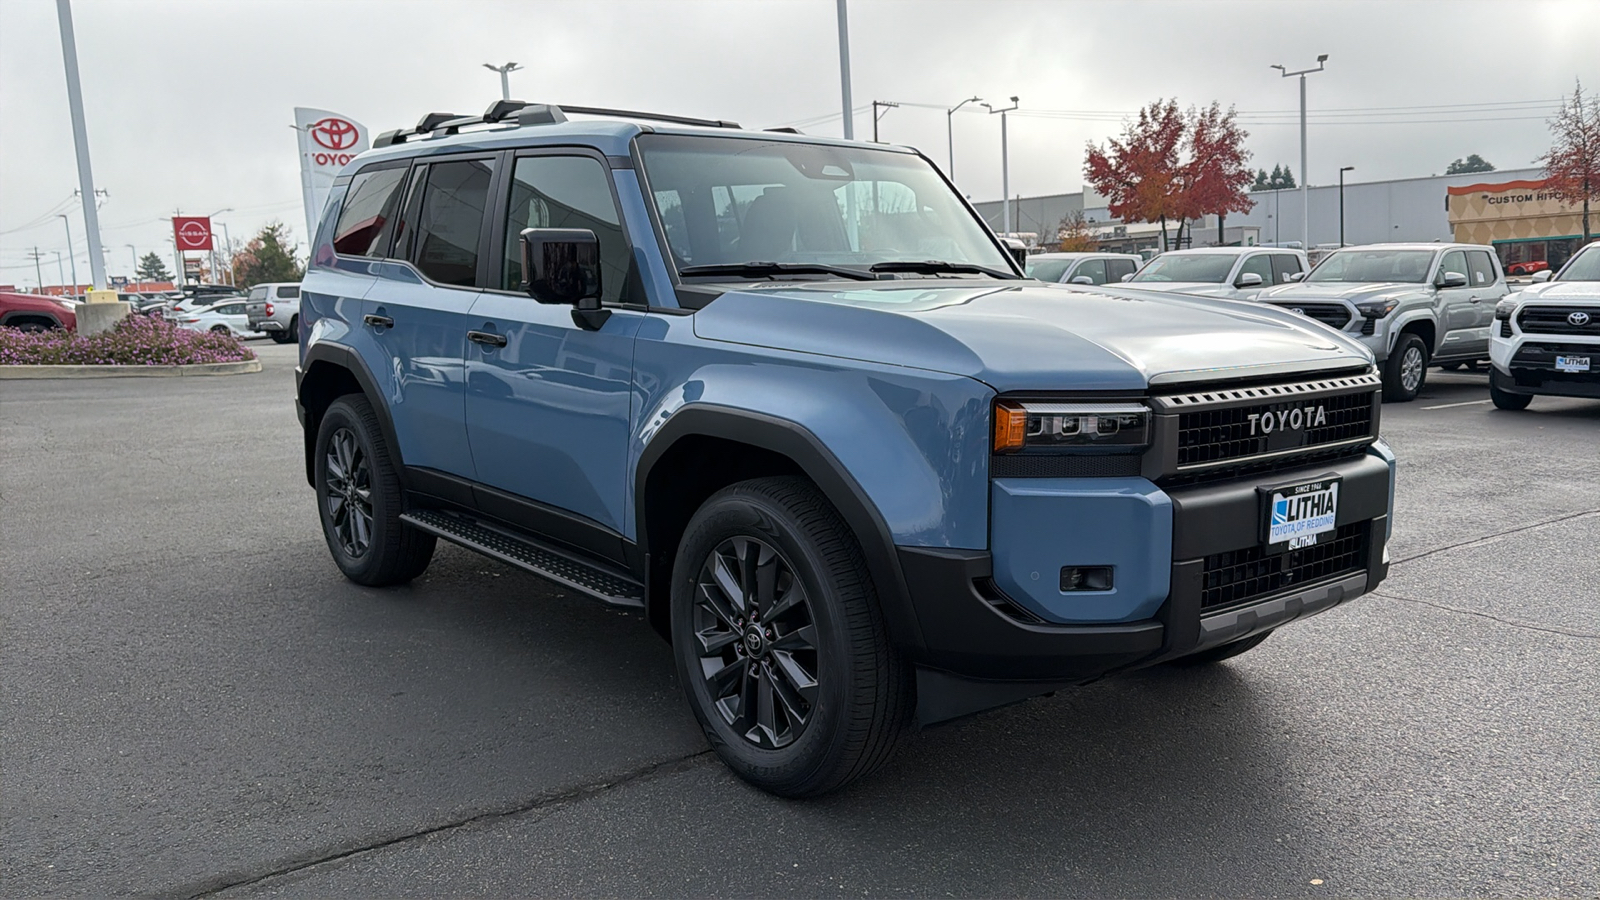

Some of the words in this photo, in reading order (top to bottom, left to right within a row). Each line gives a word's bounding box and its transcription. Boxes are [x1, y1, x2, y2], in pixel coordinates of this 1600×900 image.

[304, 153, 358, 166] OYO
[1488, 194, 1533, 205] CUSTOM
[1564, 357, 1589, 366] LITHIA
[1247, 405, 1327, 436] TOYOTA
[1294, 484, 1310, 494] SINCE
[1287, 491, 1334, 522] LITHIA
[1271, 523, 1295, 537] TOYOTA
[1296, 521, 1306, 531] OF
[1306, 515, 1334, 530] REDDING
[1295, 533, 1317, 549] LITHIA
